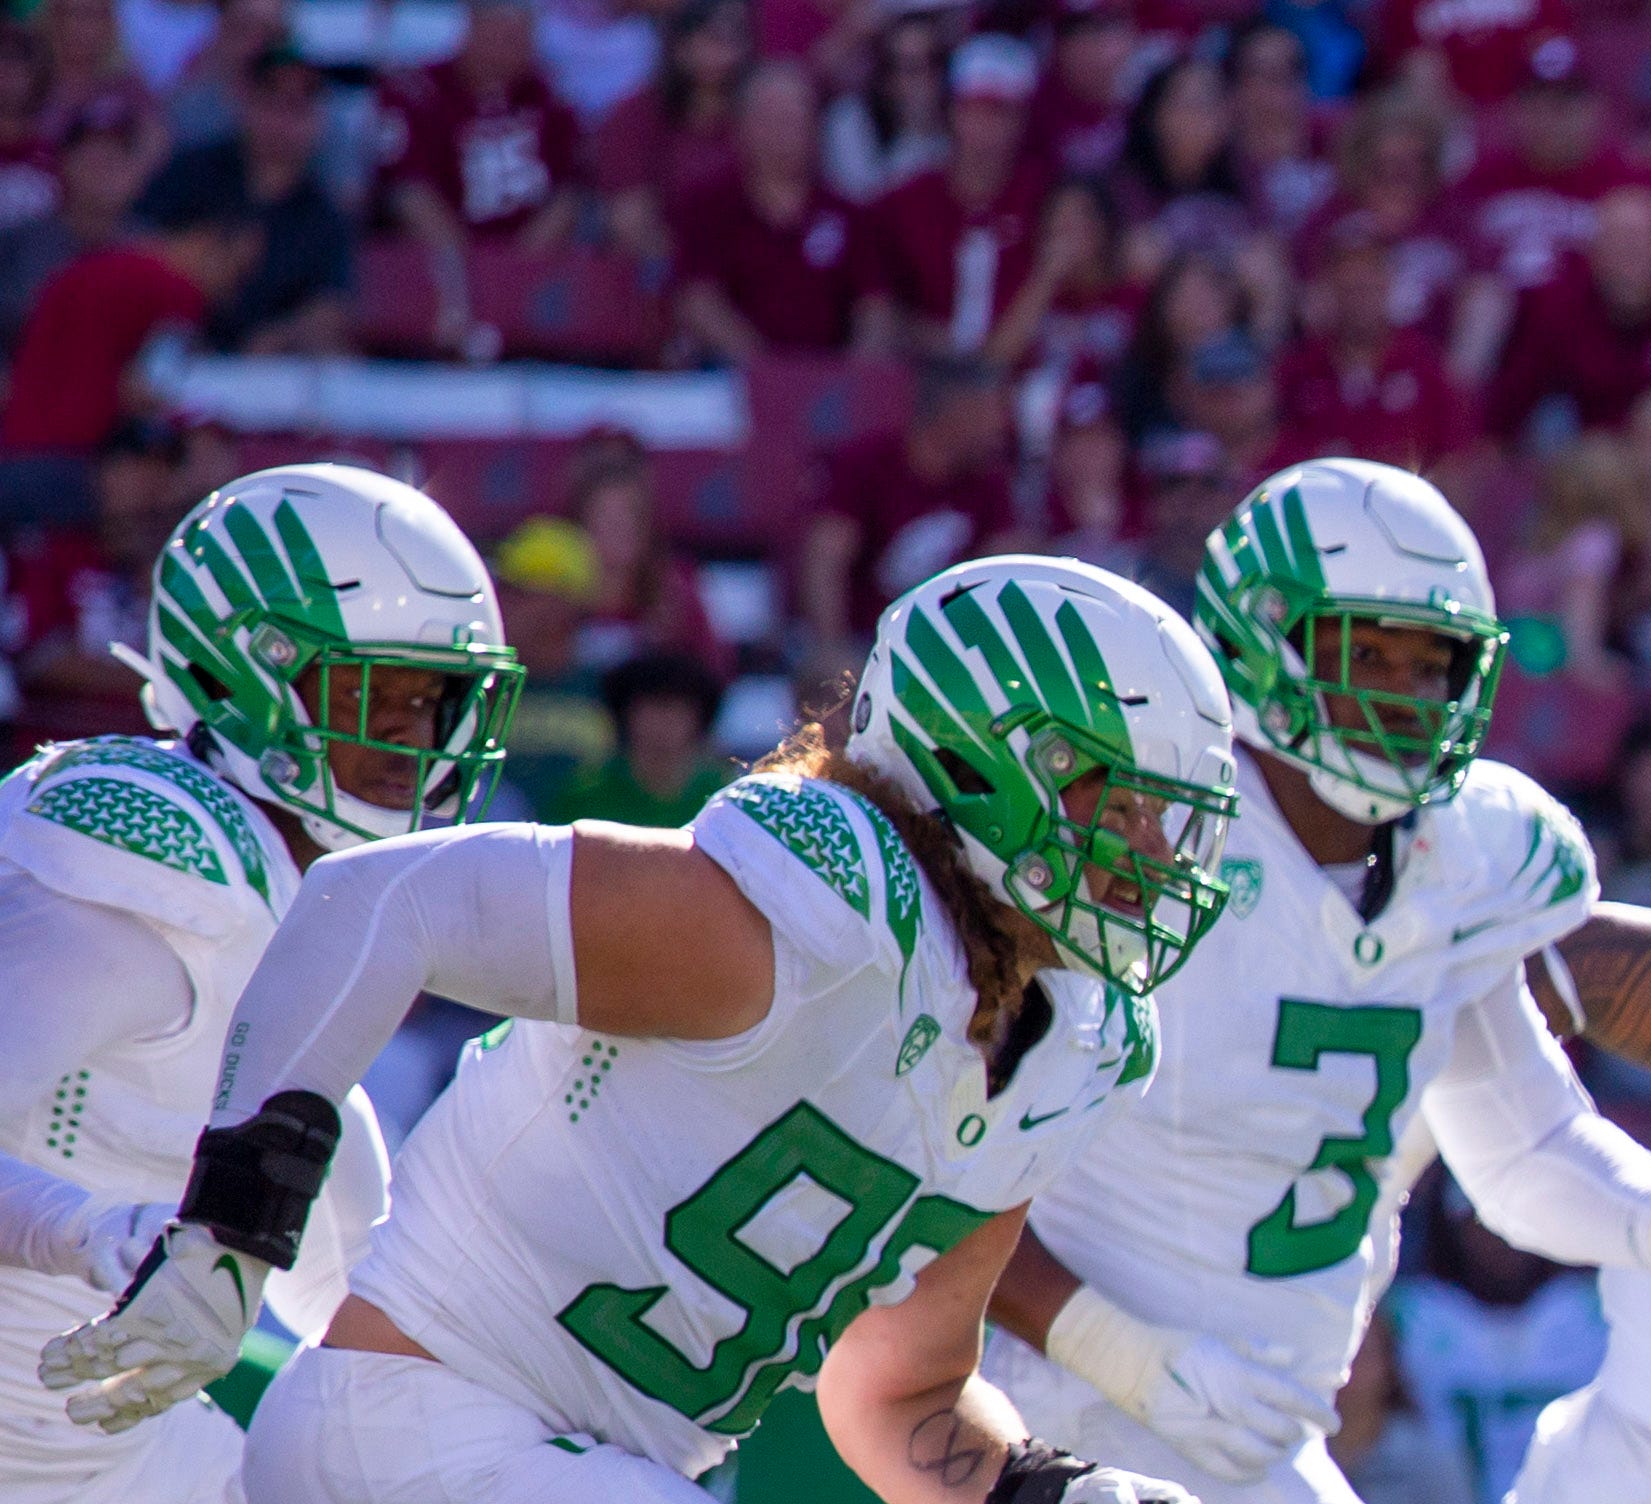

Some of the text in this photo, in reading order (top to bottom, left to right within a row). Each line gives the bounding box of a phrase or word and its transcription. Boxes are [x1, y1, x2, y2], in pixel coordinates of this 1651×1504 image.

[1353, 929, 1384, 966] O
[231, 1022, 250, 1047] GO
[956, 1113, 986, 1148] O
[1247, 997, 1424, 1277] 3
